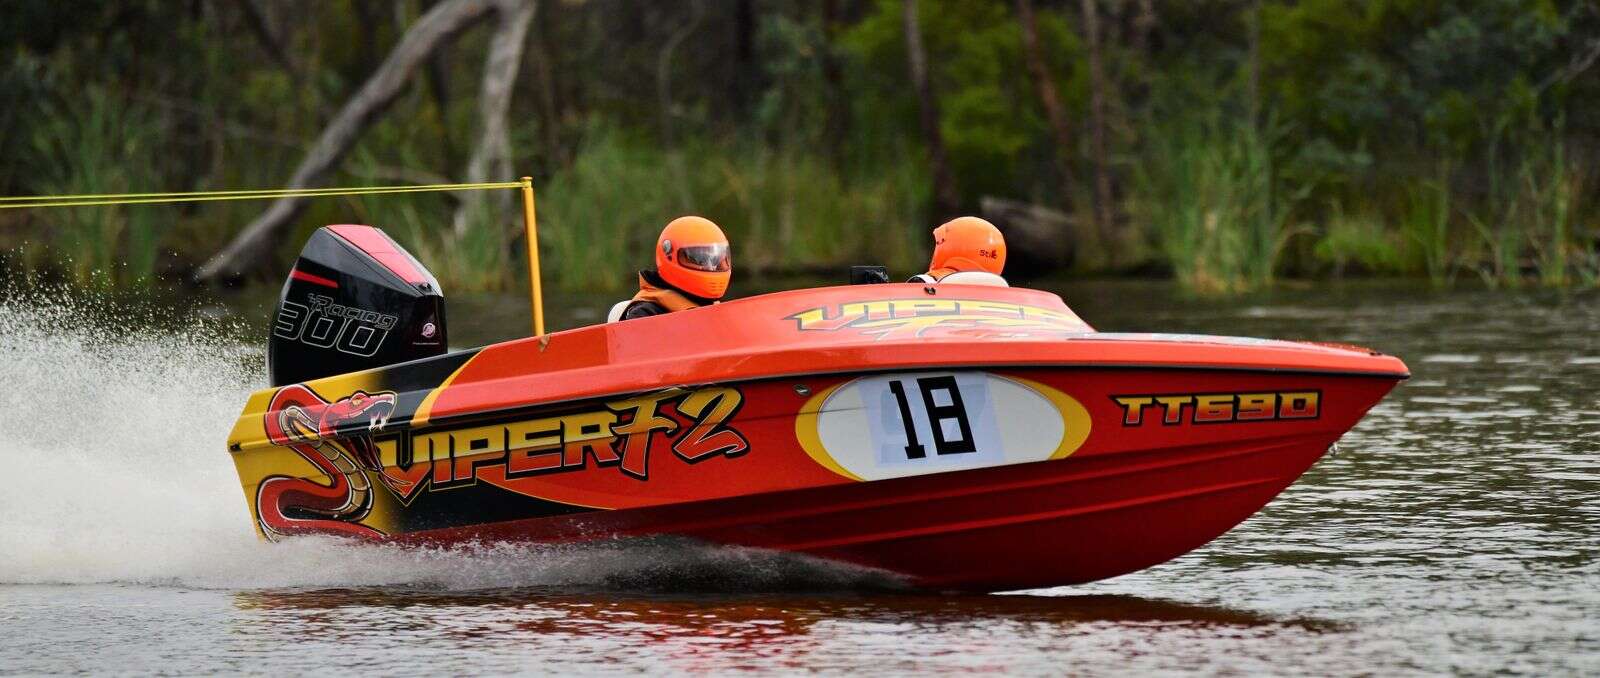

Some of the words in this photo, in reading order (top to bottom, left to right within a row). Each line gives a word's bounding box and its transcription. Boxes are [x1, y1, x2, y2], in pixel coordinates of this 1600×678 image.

[274, 300, 388, 357] 300
[307, 293, 398, 330] Racing
[888, 375, 977, 459] 18
[1110, 391, 1321, 427] TT690
[378, 405, 621, 503] VIPER
